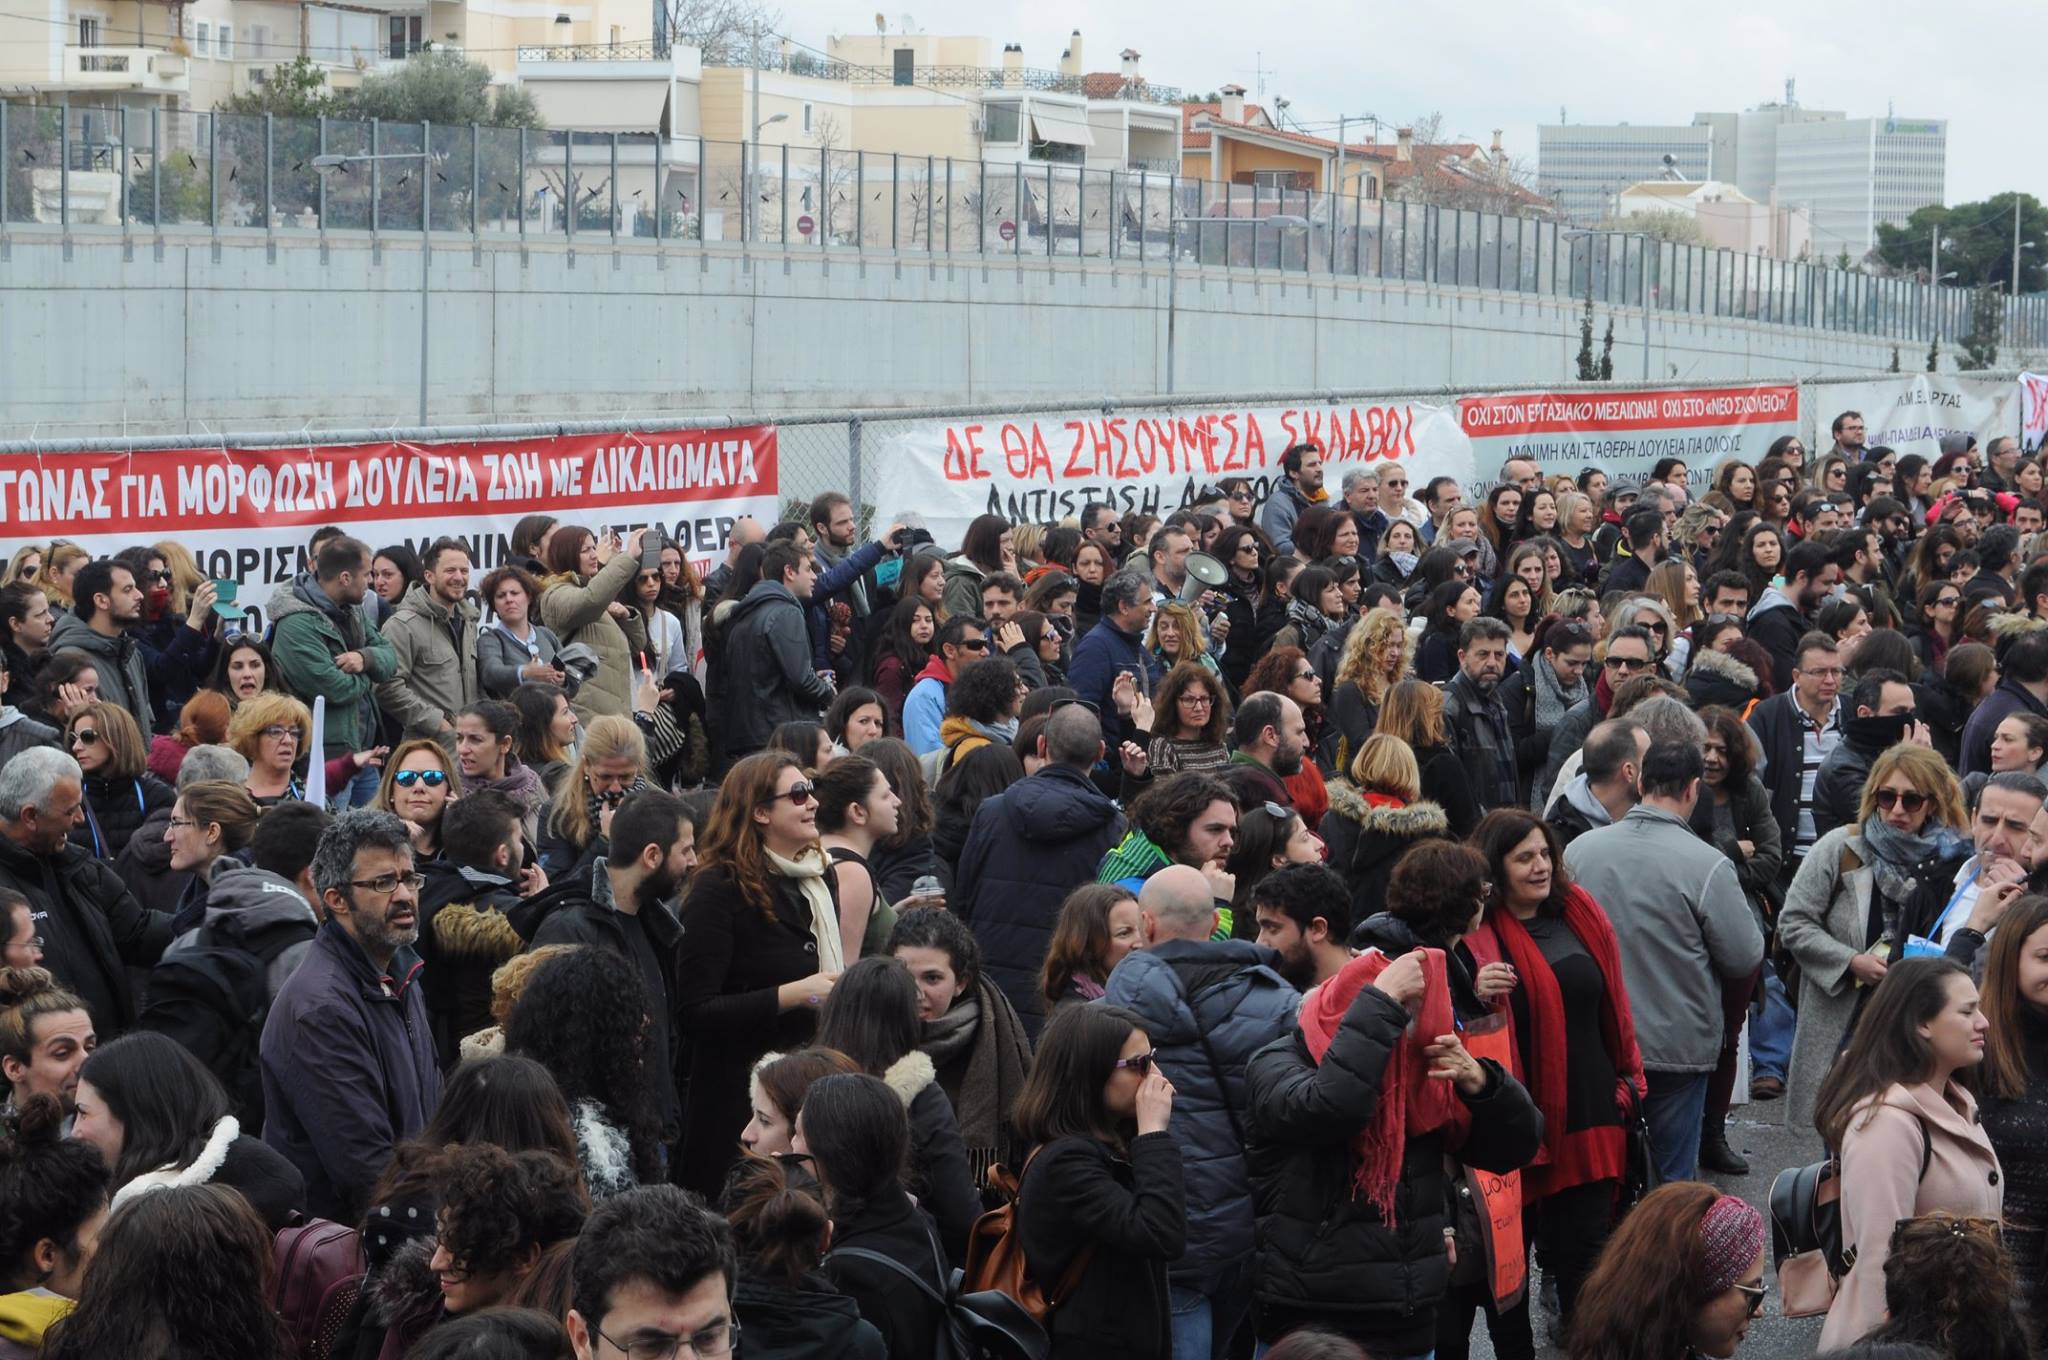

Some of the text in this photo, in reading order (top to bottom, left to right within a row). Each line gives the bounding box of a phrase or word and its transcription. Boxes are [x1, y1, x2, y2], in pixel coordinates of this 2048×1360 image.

[1467, 406, 1491, 426] ΟΧΙ
[1493, 404, 1525, 425] ΣΤΟΝ
[1527, 402, 1593, 422] ΕΡΓΑΣΙΑΚΟ
[1594, 400, 1657, 420] ΜΕΣΑΙΩΝΑ!
[1662, 400, 1681, 418] ΟΧΙ
[1683, 399, 1705, 417] ΣΤΟ
[943, 425, 992, 480] ΔΕ
[1000, 421, 1054, 484] ΘΑ
[1561, 441, 1580, 460] ΚΑΙ
[1583, 440, 1636, 459] ΣΤΑΘΕΡΗ
[1638, 437, 1685, 458] ΔΟΥΛΕΙΑ
[1704, 434, 1742, 453] ΟΛΟΥΣ
[120, 475, 167, 518] ΓΙΑ
[177, 461, 337, 516] ΜΟΡΦΩΣΗ
[345, 454, 479, 507] ΔΟΥΛΕΙΑ
[483, 451, 543, 501] ΖΩΗ
[550, 456, 583, 497] ΜΕ
[590, 439, 759, 495] ΔΙΚΑΙΩΜΑΤΑ
